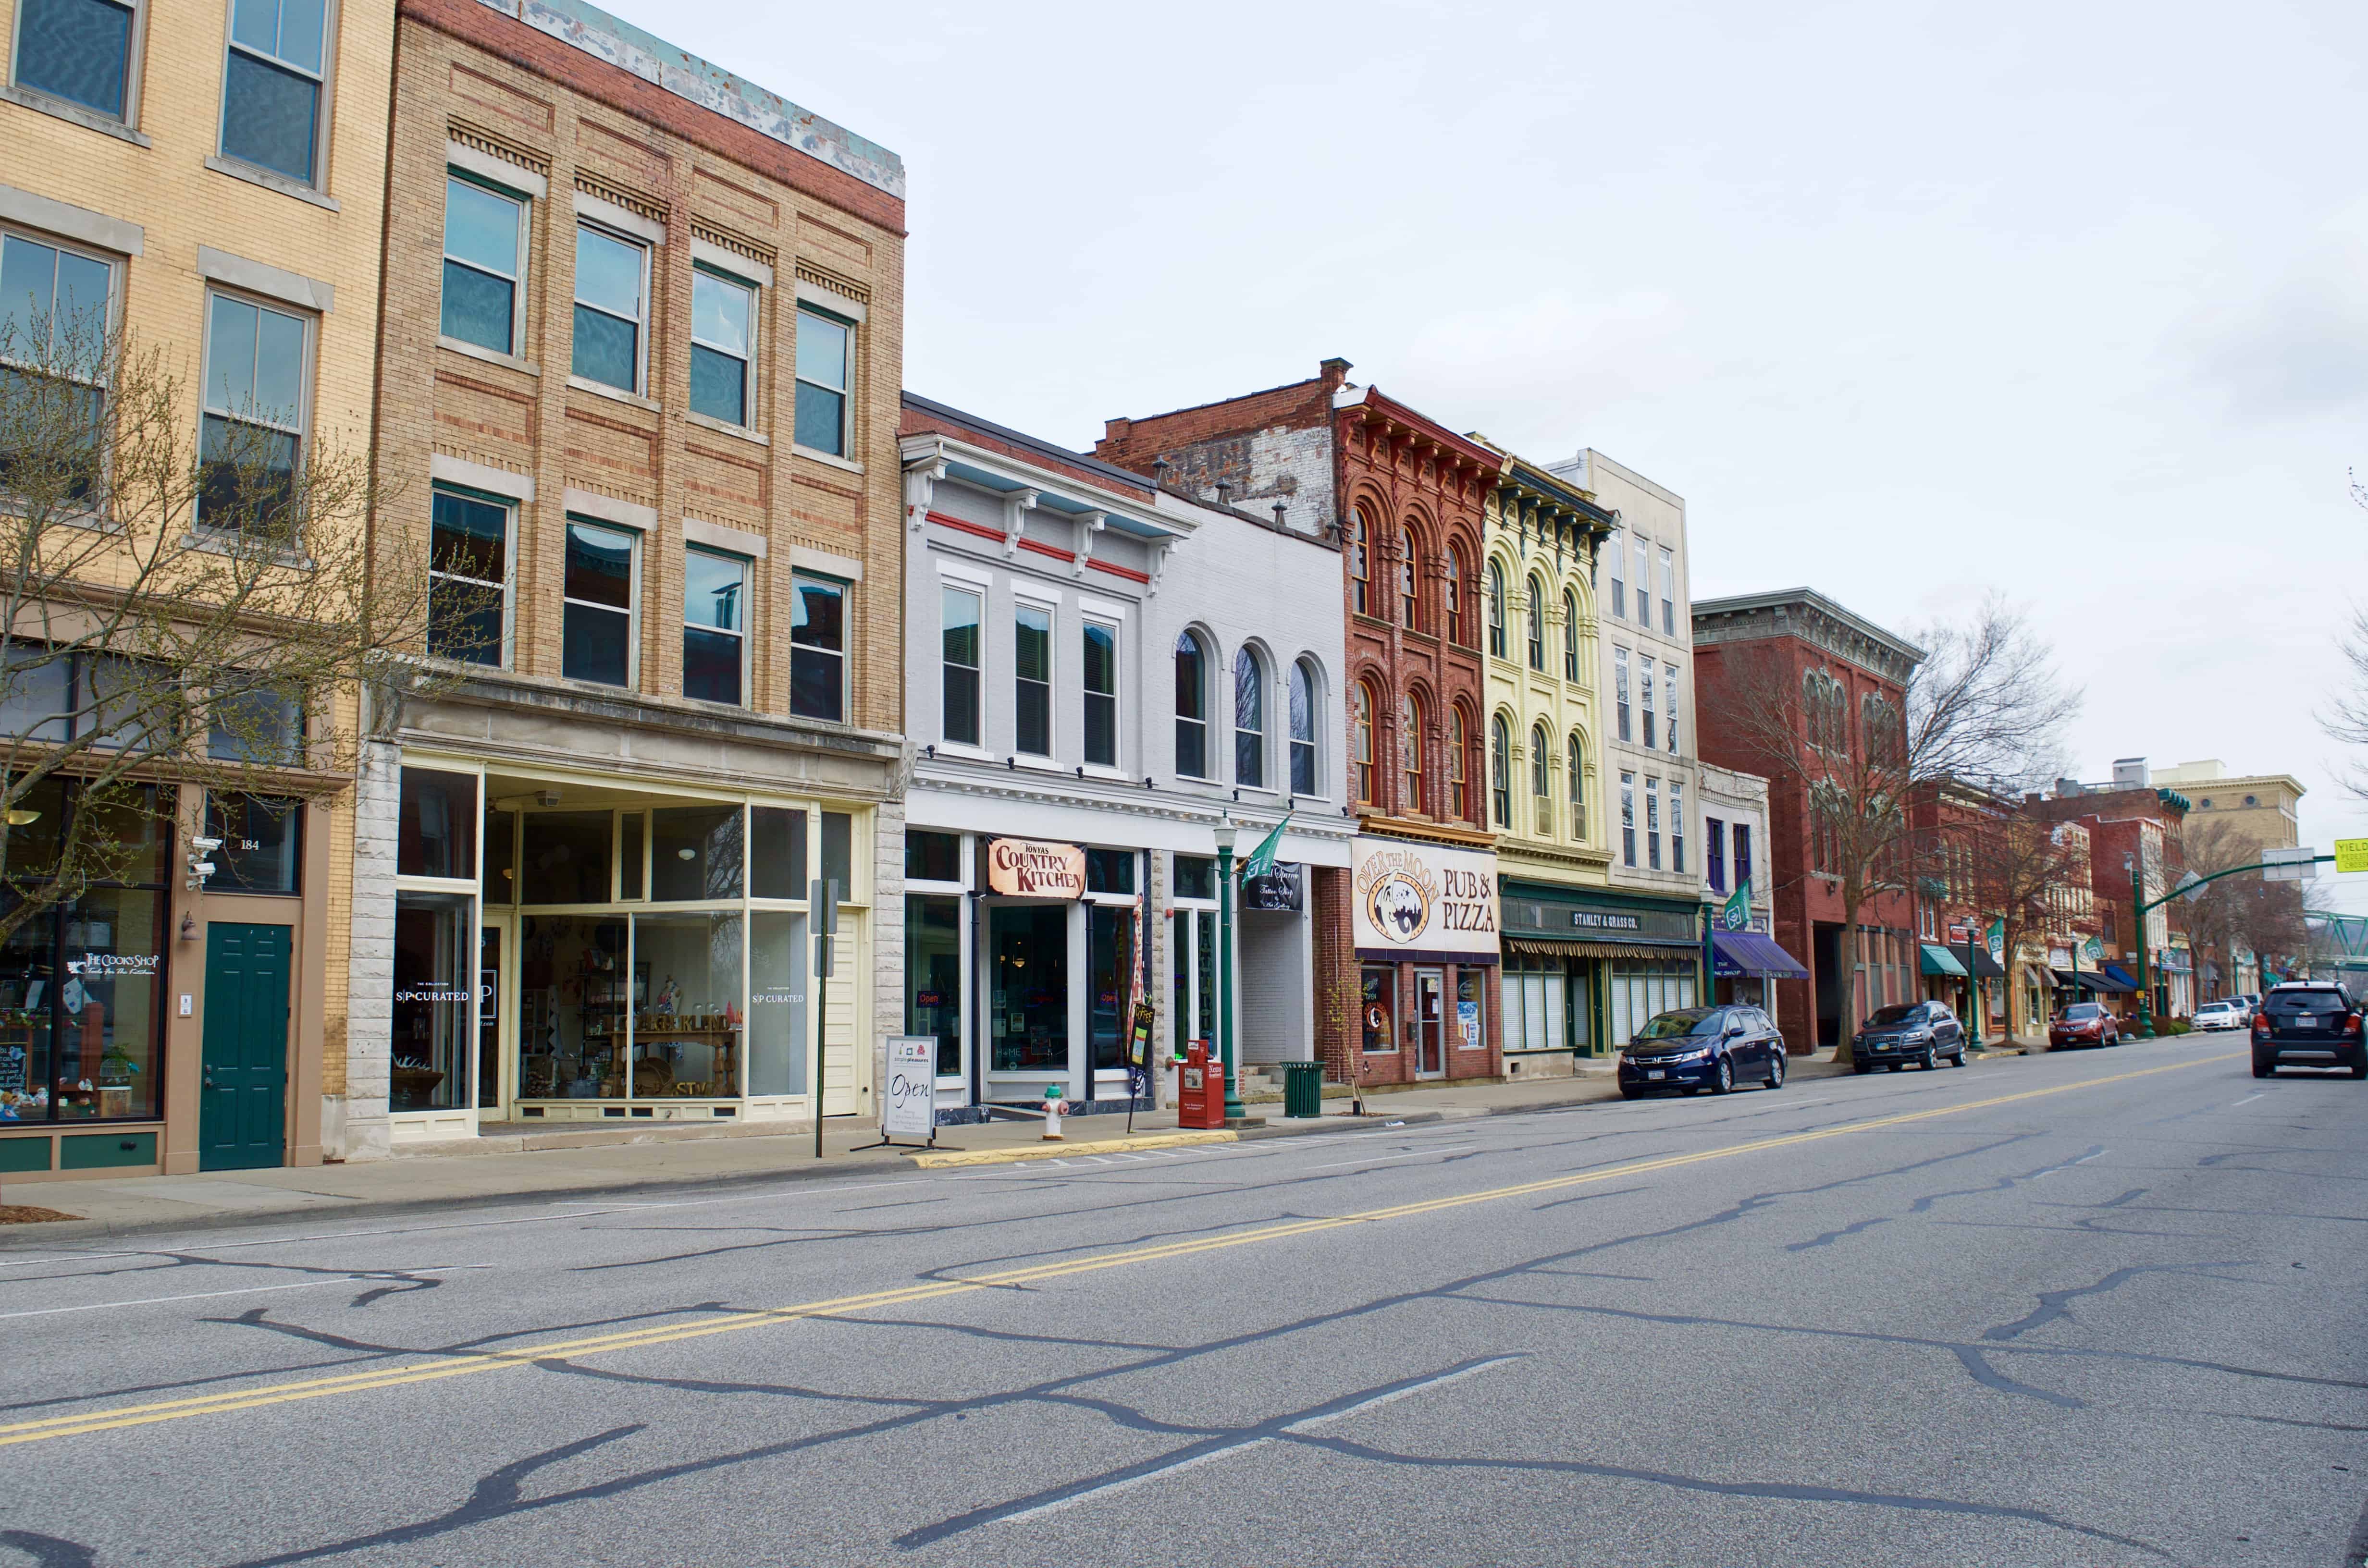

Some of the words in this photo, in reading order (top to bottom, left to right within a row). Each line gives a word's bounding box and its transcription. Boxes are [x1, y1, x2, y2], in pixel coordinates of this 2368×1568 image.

[241, 840, 259, 850] 184
[1021, 842, 1049, 854] TONYAS
[2338, 842, 2368, 852] YIELD
[996, 845, 1068, 872] COUNTRY
[1017, 867, 1081, 892] KITCHEN
[1357, 850, 1389, 894] OVER
[1386, 853, 1402, 867] THE
[1403, 850, 1440, 905] MOON
[1443, 869, 1477, 899] PUB
[1480, 873, 1492, 899] &
[1259, 884, 1277, 894] Tattoo
[1279, 885, 1293, 899] Shop
[1443, 902, 1495, 932] PIZZA
[1574, 913, 1601, 927] STANLEY
[1603, 916, 1608, 928] &
[1609, 916, 1627, 929] GRASS
[1628, 917, 1638, 929] CO.
[86, 953, 100, 967] THE
[134, 954, 159, 968] SHOP
[415, 992, 469, 1002] CURATED
[765, 995, 804, 1003] CURATED
[919, 994, 938, 1005] Open
[1459, 1005, 1477, 1015] BUSCH
[1209, 1065, 1221, 1073] News
[891, 1074, 930, 1109] Open
